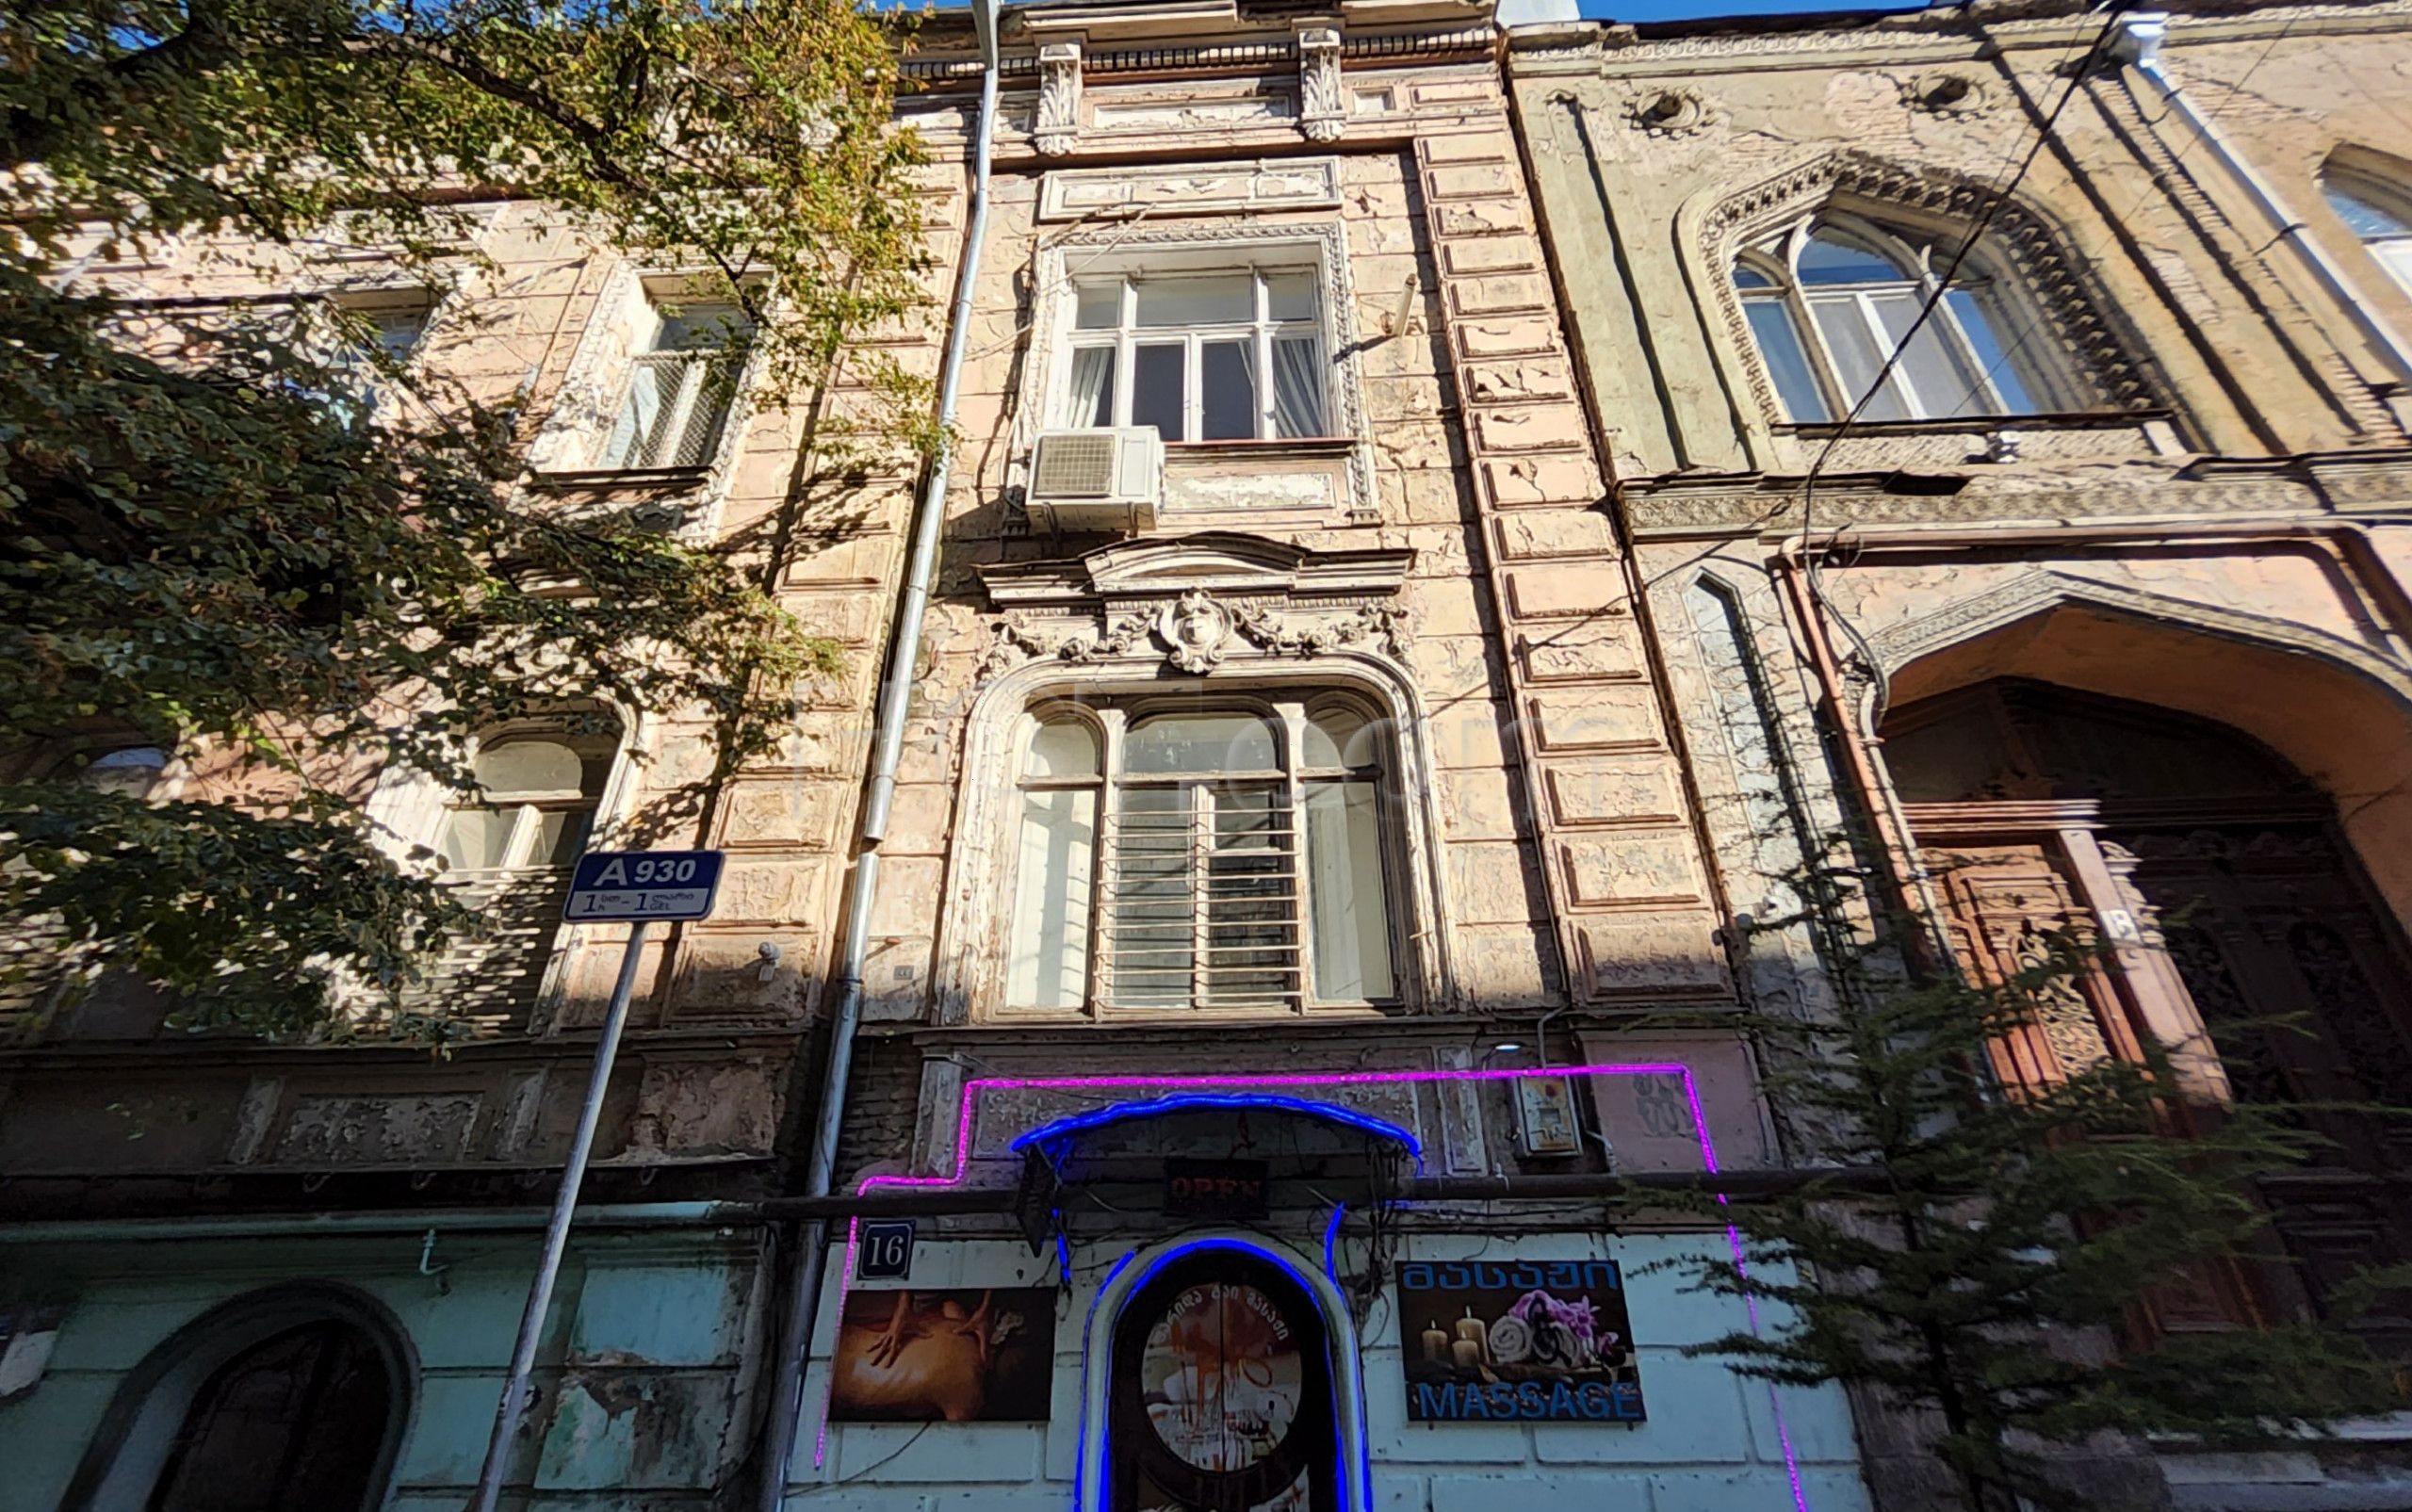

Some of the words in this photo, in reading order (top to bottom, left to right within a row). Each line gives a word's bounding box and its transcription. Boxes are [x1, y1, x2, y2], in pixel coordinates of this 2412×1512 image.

[593, 857, 628, 886] A
[634, 859, 697, 883] 930
[869, 1235, 904, 1266] 16
[1403, 1262, 1620, 1291] მასაჟი
[1417, 1380, 1641, 1419] MASSAGE
